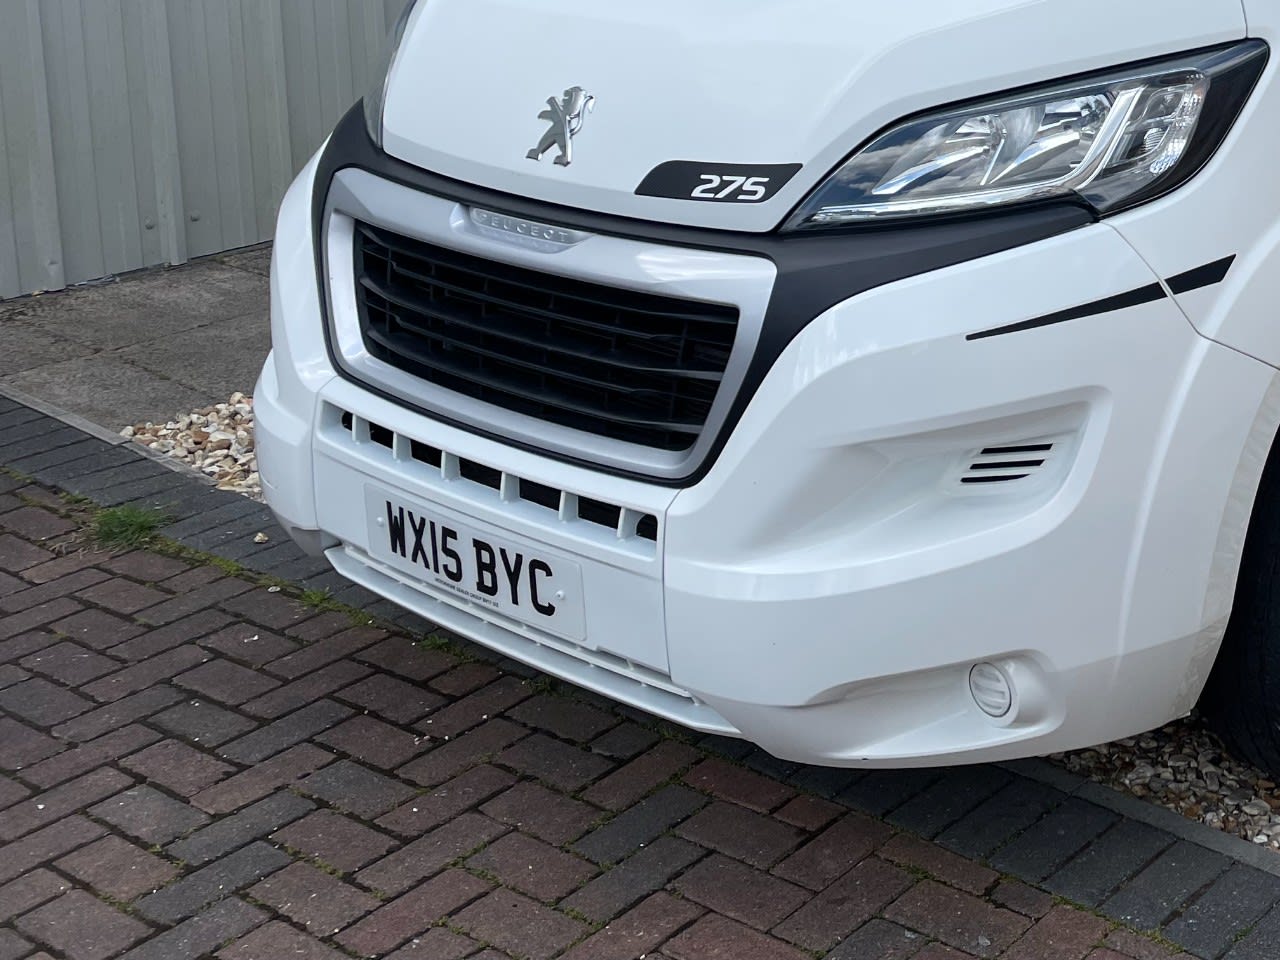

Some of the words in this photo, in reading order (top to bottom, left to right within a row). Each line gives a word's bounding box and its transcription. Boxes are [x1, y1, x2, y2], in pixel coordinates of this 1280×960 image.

[691, 174, 770, 200] 275
[386, 500, 463, 583] WX15
[472, 537, 556, 617] BYC
